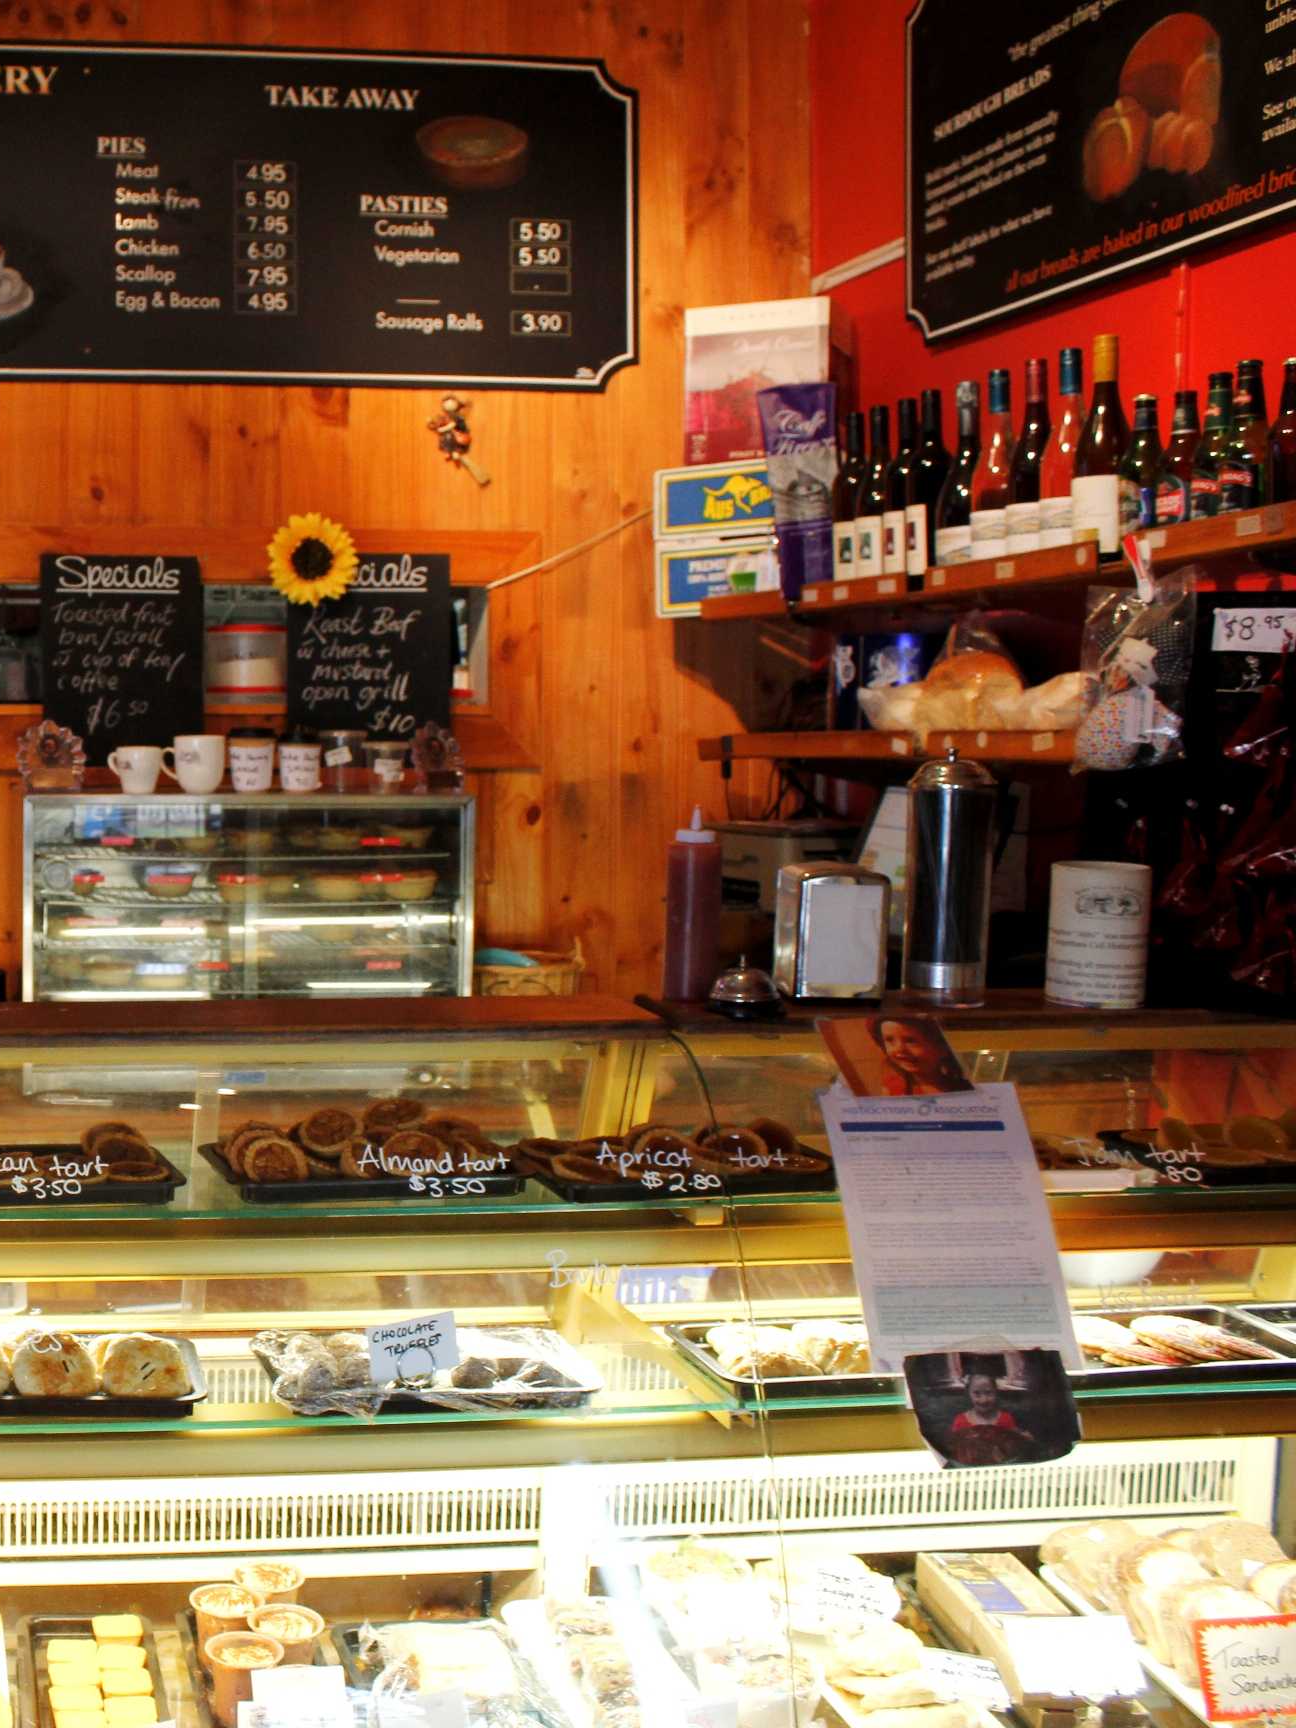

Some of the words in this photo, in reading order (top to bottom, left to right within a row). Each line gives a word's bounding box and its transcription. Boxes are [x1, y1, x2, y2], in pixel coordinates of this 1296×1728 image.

[265, 85, 338, 108] TAKE
[344, 88, 419, 111] AWAY
[97, 136, 146, 154] PIES
[116, 163, 159, 178] Meat
[246, 163, 287, 183] 4.95
[115, 187, 160, 205] Steak
[360, 195, 448, 215] PASTIES
[115, 213, 159, 231] Lamb
[375, 221, 434, 239] Cornish
[519, 222, 561, 241] 5.50
[115, 238, 180, 257] Chicken
[375, 246, 459, 266] Vegetarian
[519, 248, 560, 266] 5.50
[115, 264, 176, 285] Scallop
[247, 267, 288, 287] 7.95
[115, 291, 147, 312] Egg
[152, 291, 165, 308] &
[170, 292, 221, 309] Bacon
[248, 292, 288, 311] 4.95
[375, 313, 443, 334] Sausage
[447, 313, 483, 332] Rolls
[521, 314, 562, 332] 3.90
[56, 555, 180, 597] Specials
[51, 599, 129, 625] Toasted
[304, 605, 363, 644] Roast
[369, 606, 422, 641] Beef
[118, 647, 139, 668] of
[312, 660, 393, 681] mustard
[302, 686, 349, 710] open
[356, 672, 410, 711] grill
[368, 705, 415, 733] $10
[357, 1144, 454, 1174] Almond
[459, 1152, 511, 1173] tart
[596, 1141, 693, 1177] Apricot
[729, 1147, 788, 1168] tart
[1064, 1138, 1136, 1167] Jam
[1145, 1142, 1206, 1163] tart
[49, 1155, 109, 1177] tart
[11, 1175, 82, 1199] $3.50
[409, 1174, 486, 1198] $3.50
[641, 1170, 721, 1192] $2.80
[372, 1320, 439, 1343] CHOCOLATE
[1212, 1641, 1281, 1671] Toasted
